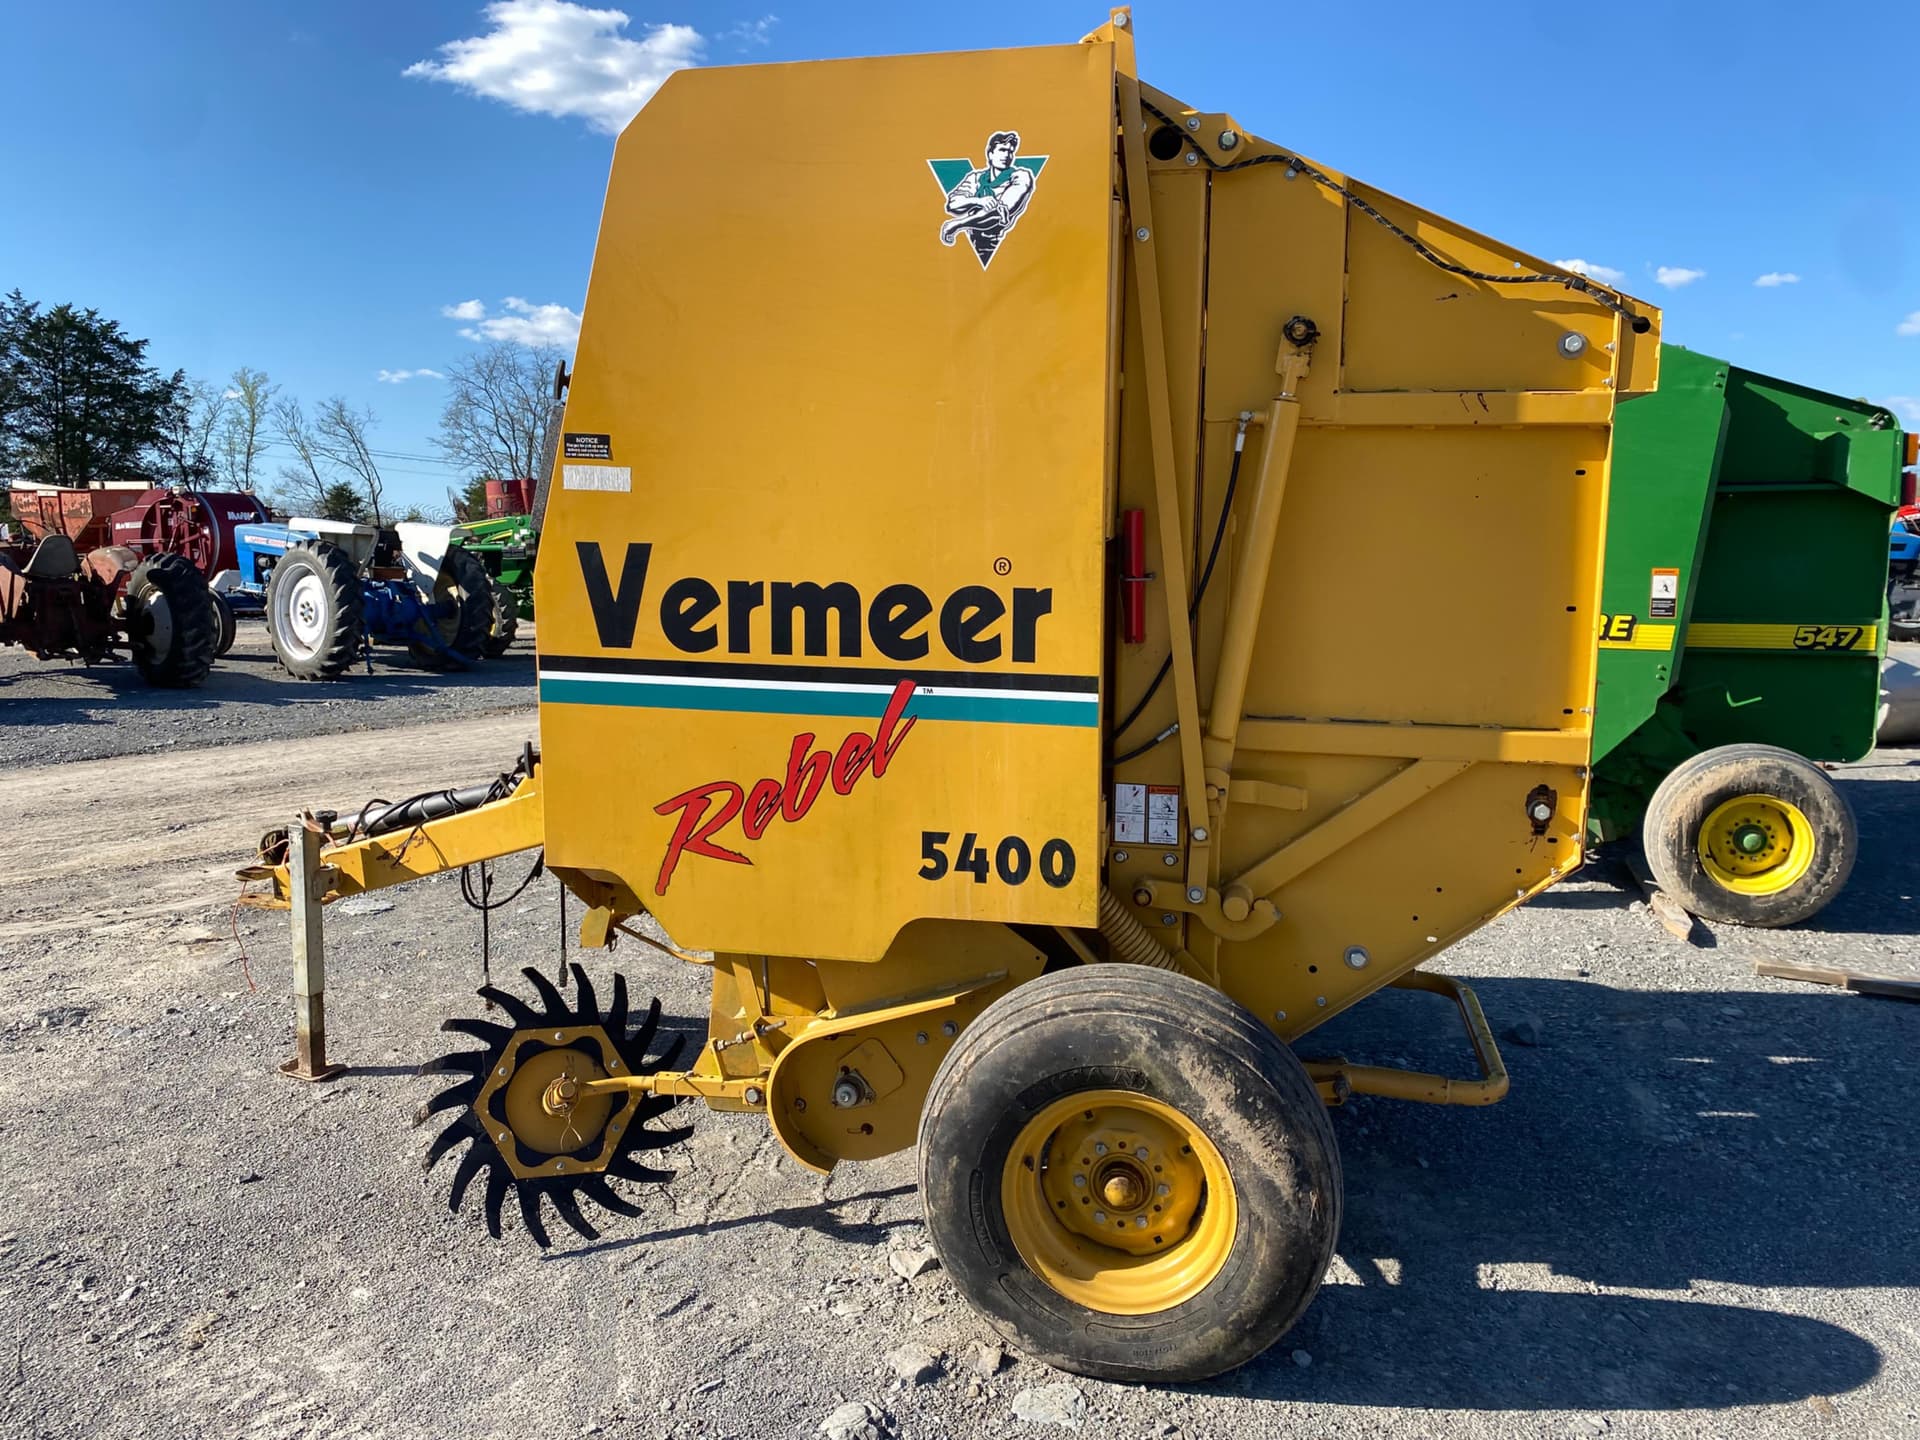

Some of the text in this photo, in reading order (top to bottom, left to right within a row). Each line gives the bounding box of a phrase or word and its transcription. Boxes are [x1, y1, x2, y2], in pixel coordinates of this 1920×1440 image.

[575, 541, 1053, 664] Vermeer
[1794, 626, 1862, 649] 547
[653, 679, 918, 897] Rebel
[918, 831, 1077, 889] 5400
